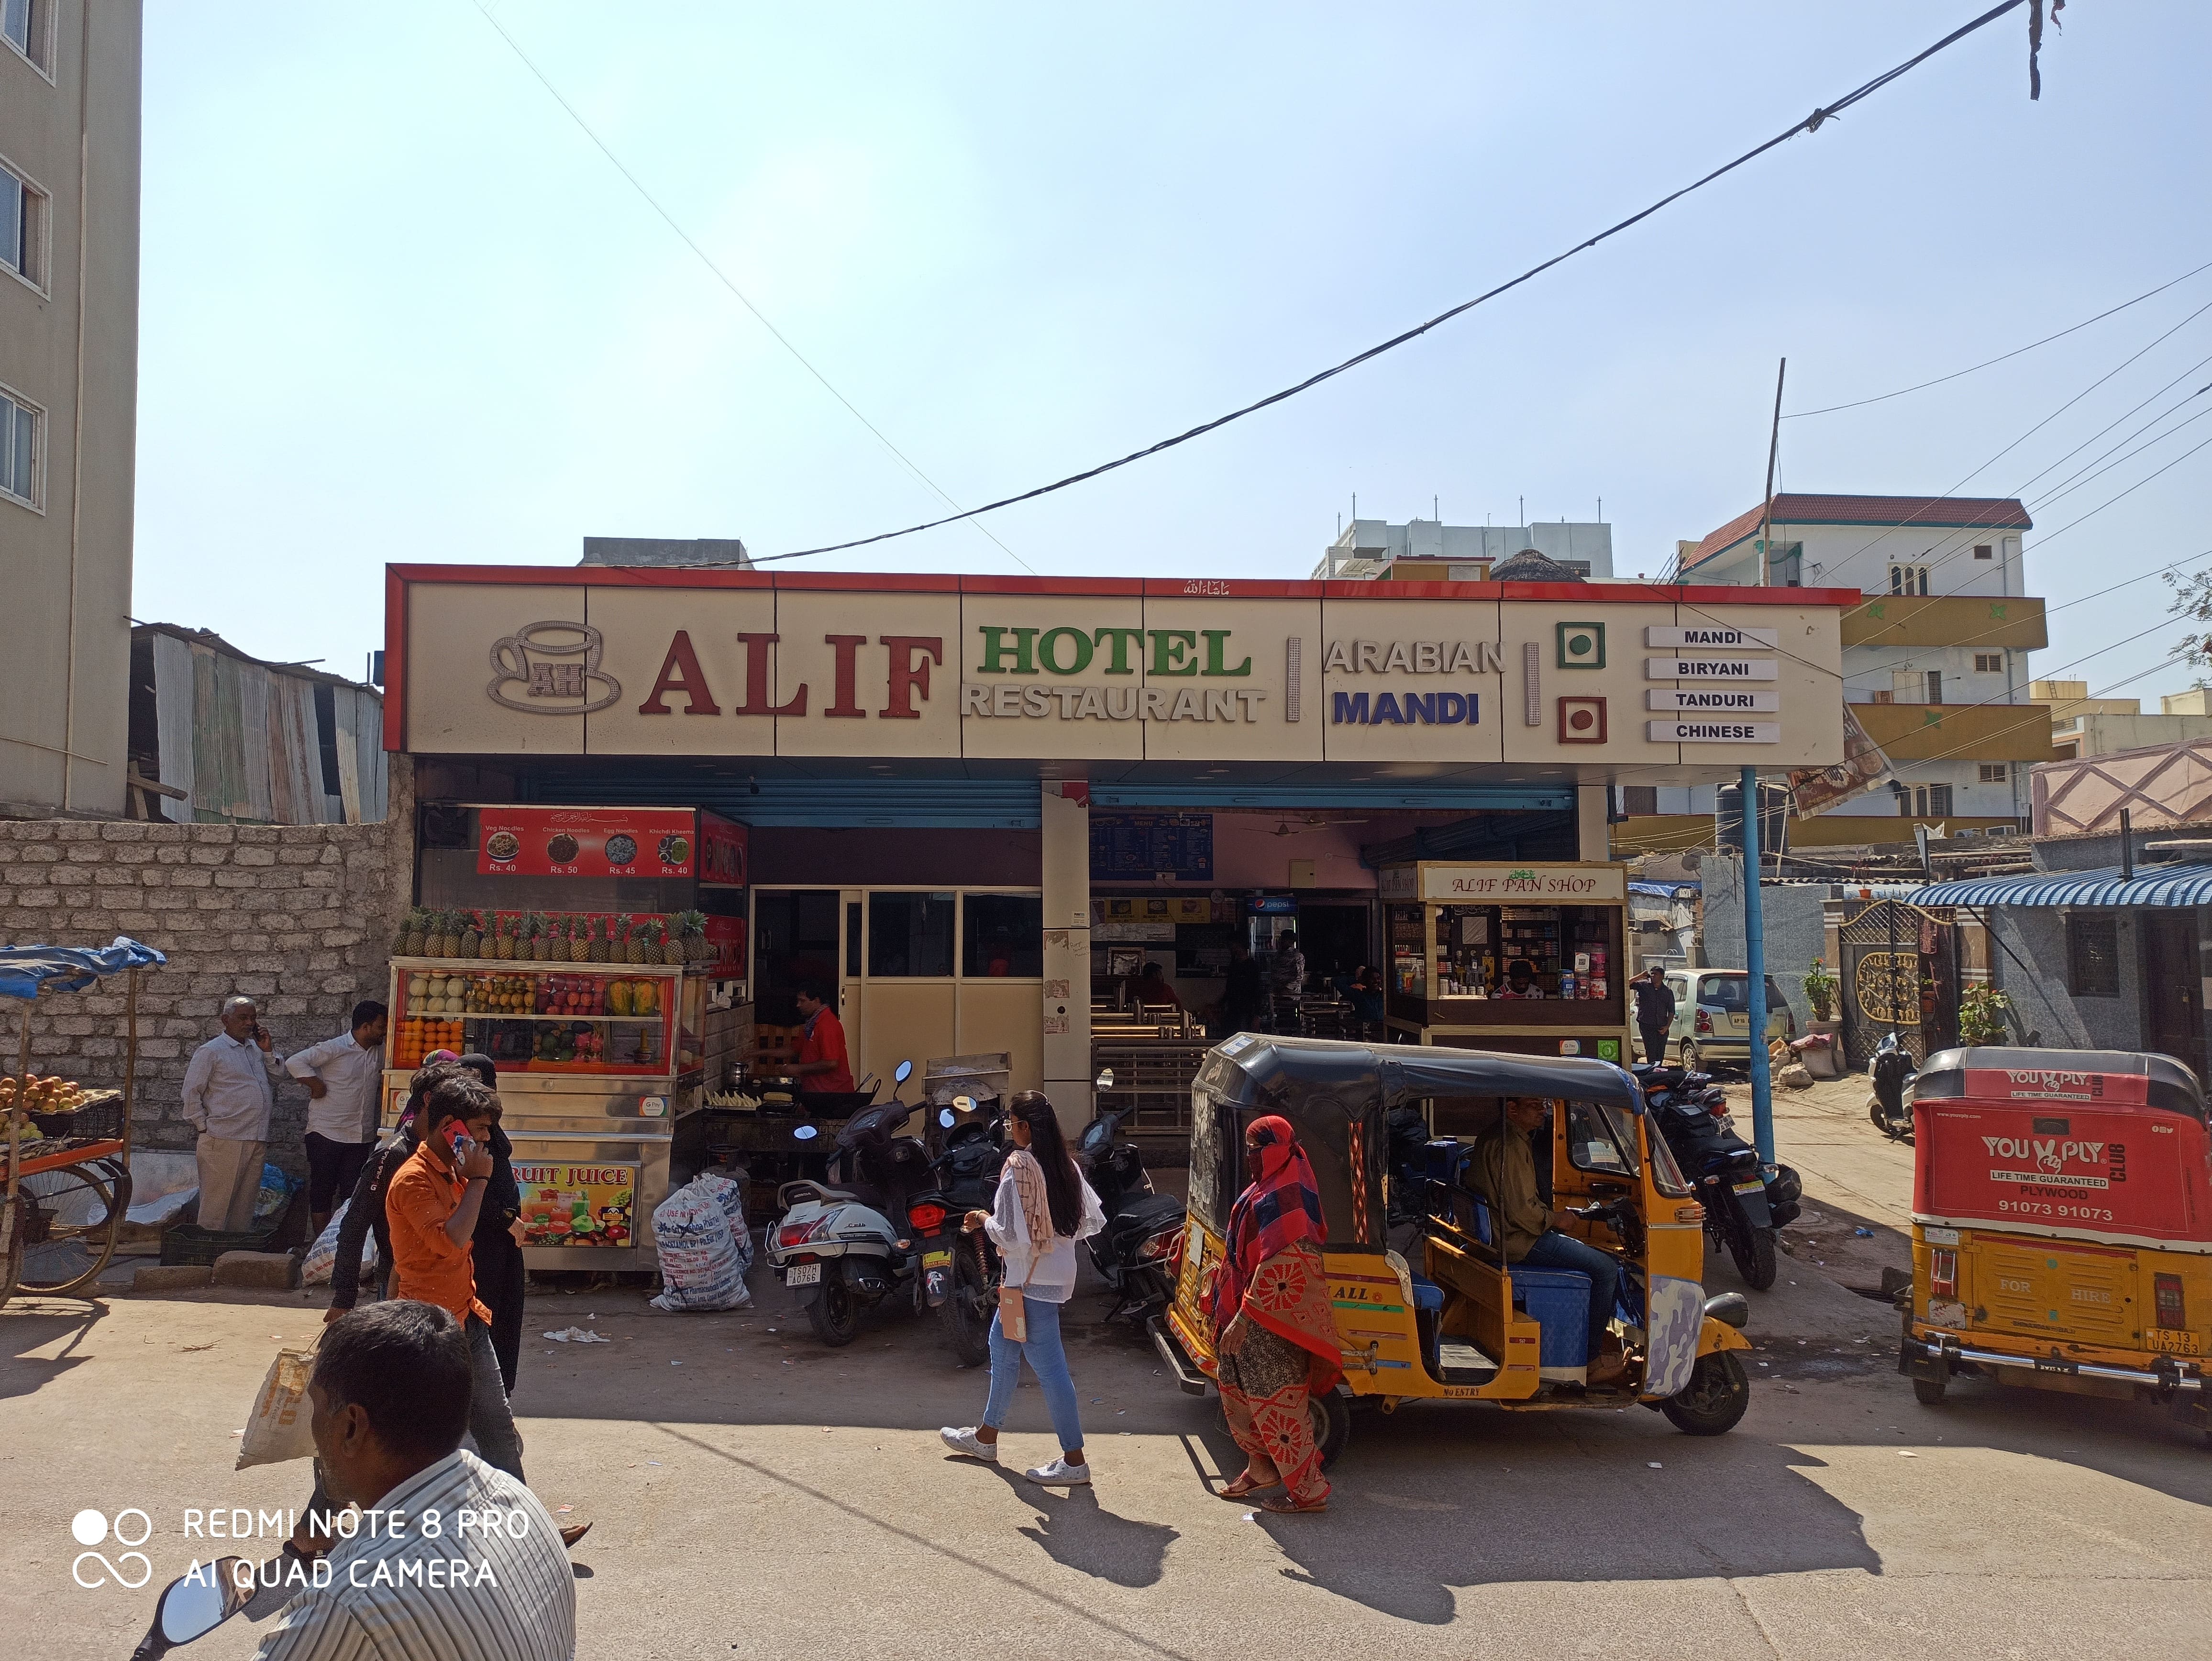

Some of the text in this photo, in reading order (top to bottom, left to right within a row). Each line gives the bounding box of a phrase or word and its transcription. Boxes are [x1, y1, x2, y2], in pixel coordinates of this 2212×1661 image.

[1684, 631, 1742, 644] MANDI
[978, 625, 1252, 676] HOTEL
[1323, 640, 1508, 673] ARABIAN
[638, 630, 942, 719] ALIF
[1678, 662, 1749, 675] BIRYANI
[527, 663, 585, 698] AH
[961, 684, 1267, 723] RESTAURANT
[1675, 694, 1754, 707] TANDURI
[1332, 692, 1480, 726] MANDI
[1676, 725, 1755, 738] CHINESE
[1452, 875, 1596, 892] ALIF PAN SHOP
[1267, 901, 1289, 909] pepsi
[2006, 1071, 2038, 1084] YOU
[2092, 1074, 2103, 1096] CLUB
[1981, 1136, 2029, 1159] YOU
[2108, 1143, 2126, 1182] CLUB
[511, 1166, 628, 1185] RUIT JUICE
[1991, 1172, 2107, 1187] LIFE TIME GUARANTEED
[2020, 1185, 2088, 1200] PLYWOOD
[1999, 1200, 2113, 1221] 91073 91073
[793, 1265, 817, 1275] TS07H
[2000, 1278, 2032, 1292] FOR
[2070, 1288, 2111, 1304] HIRE
[2156, 1330, 2190, 1343] TS 13
[2153, 1340, 2199, 1354] UA2763
